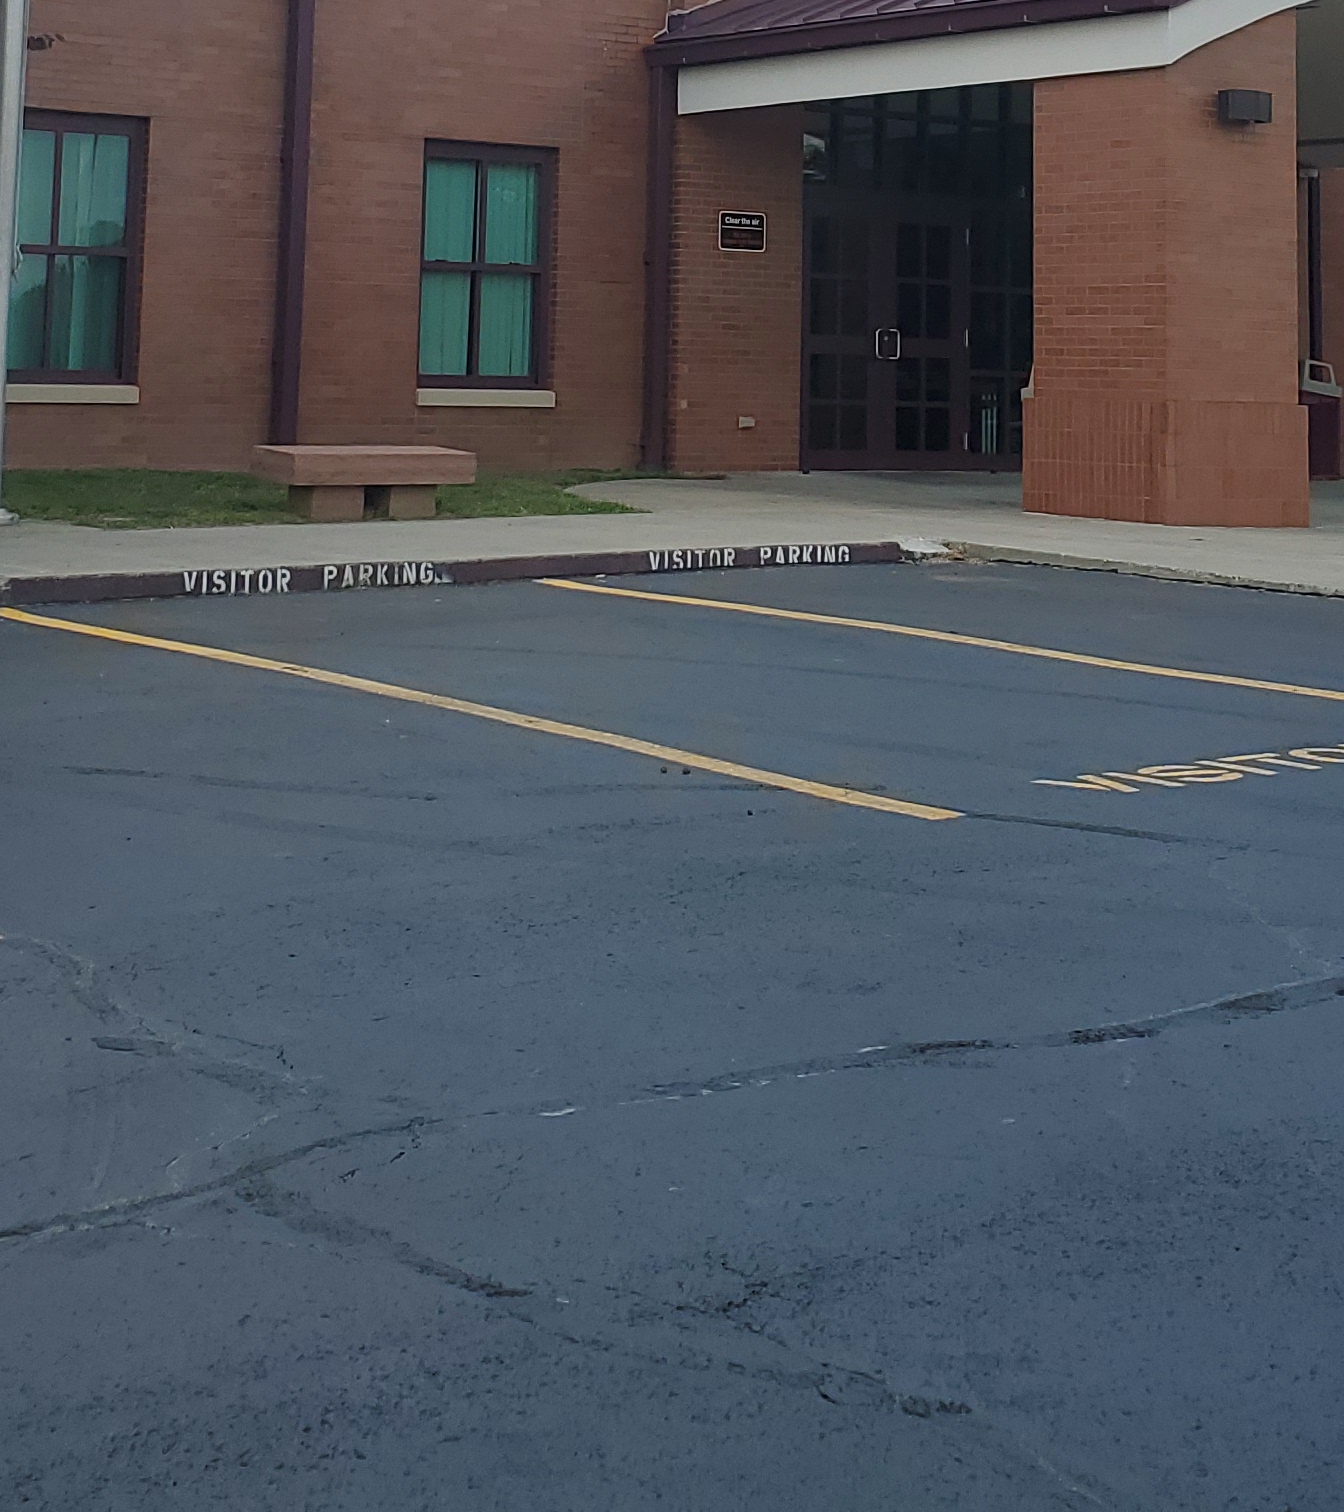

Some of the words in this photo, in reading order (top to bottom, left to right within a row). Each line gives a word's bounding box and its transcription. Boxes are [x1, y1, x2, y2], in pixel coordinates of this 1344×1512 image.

[645, 548, 736, 571] VISITOR
[760, 545, 850, 566] PARKING
[183, 569, 292, 595] VISITOR
[323, 562, 436, 589] PARKING
